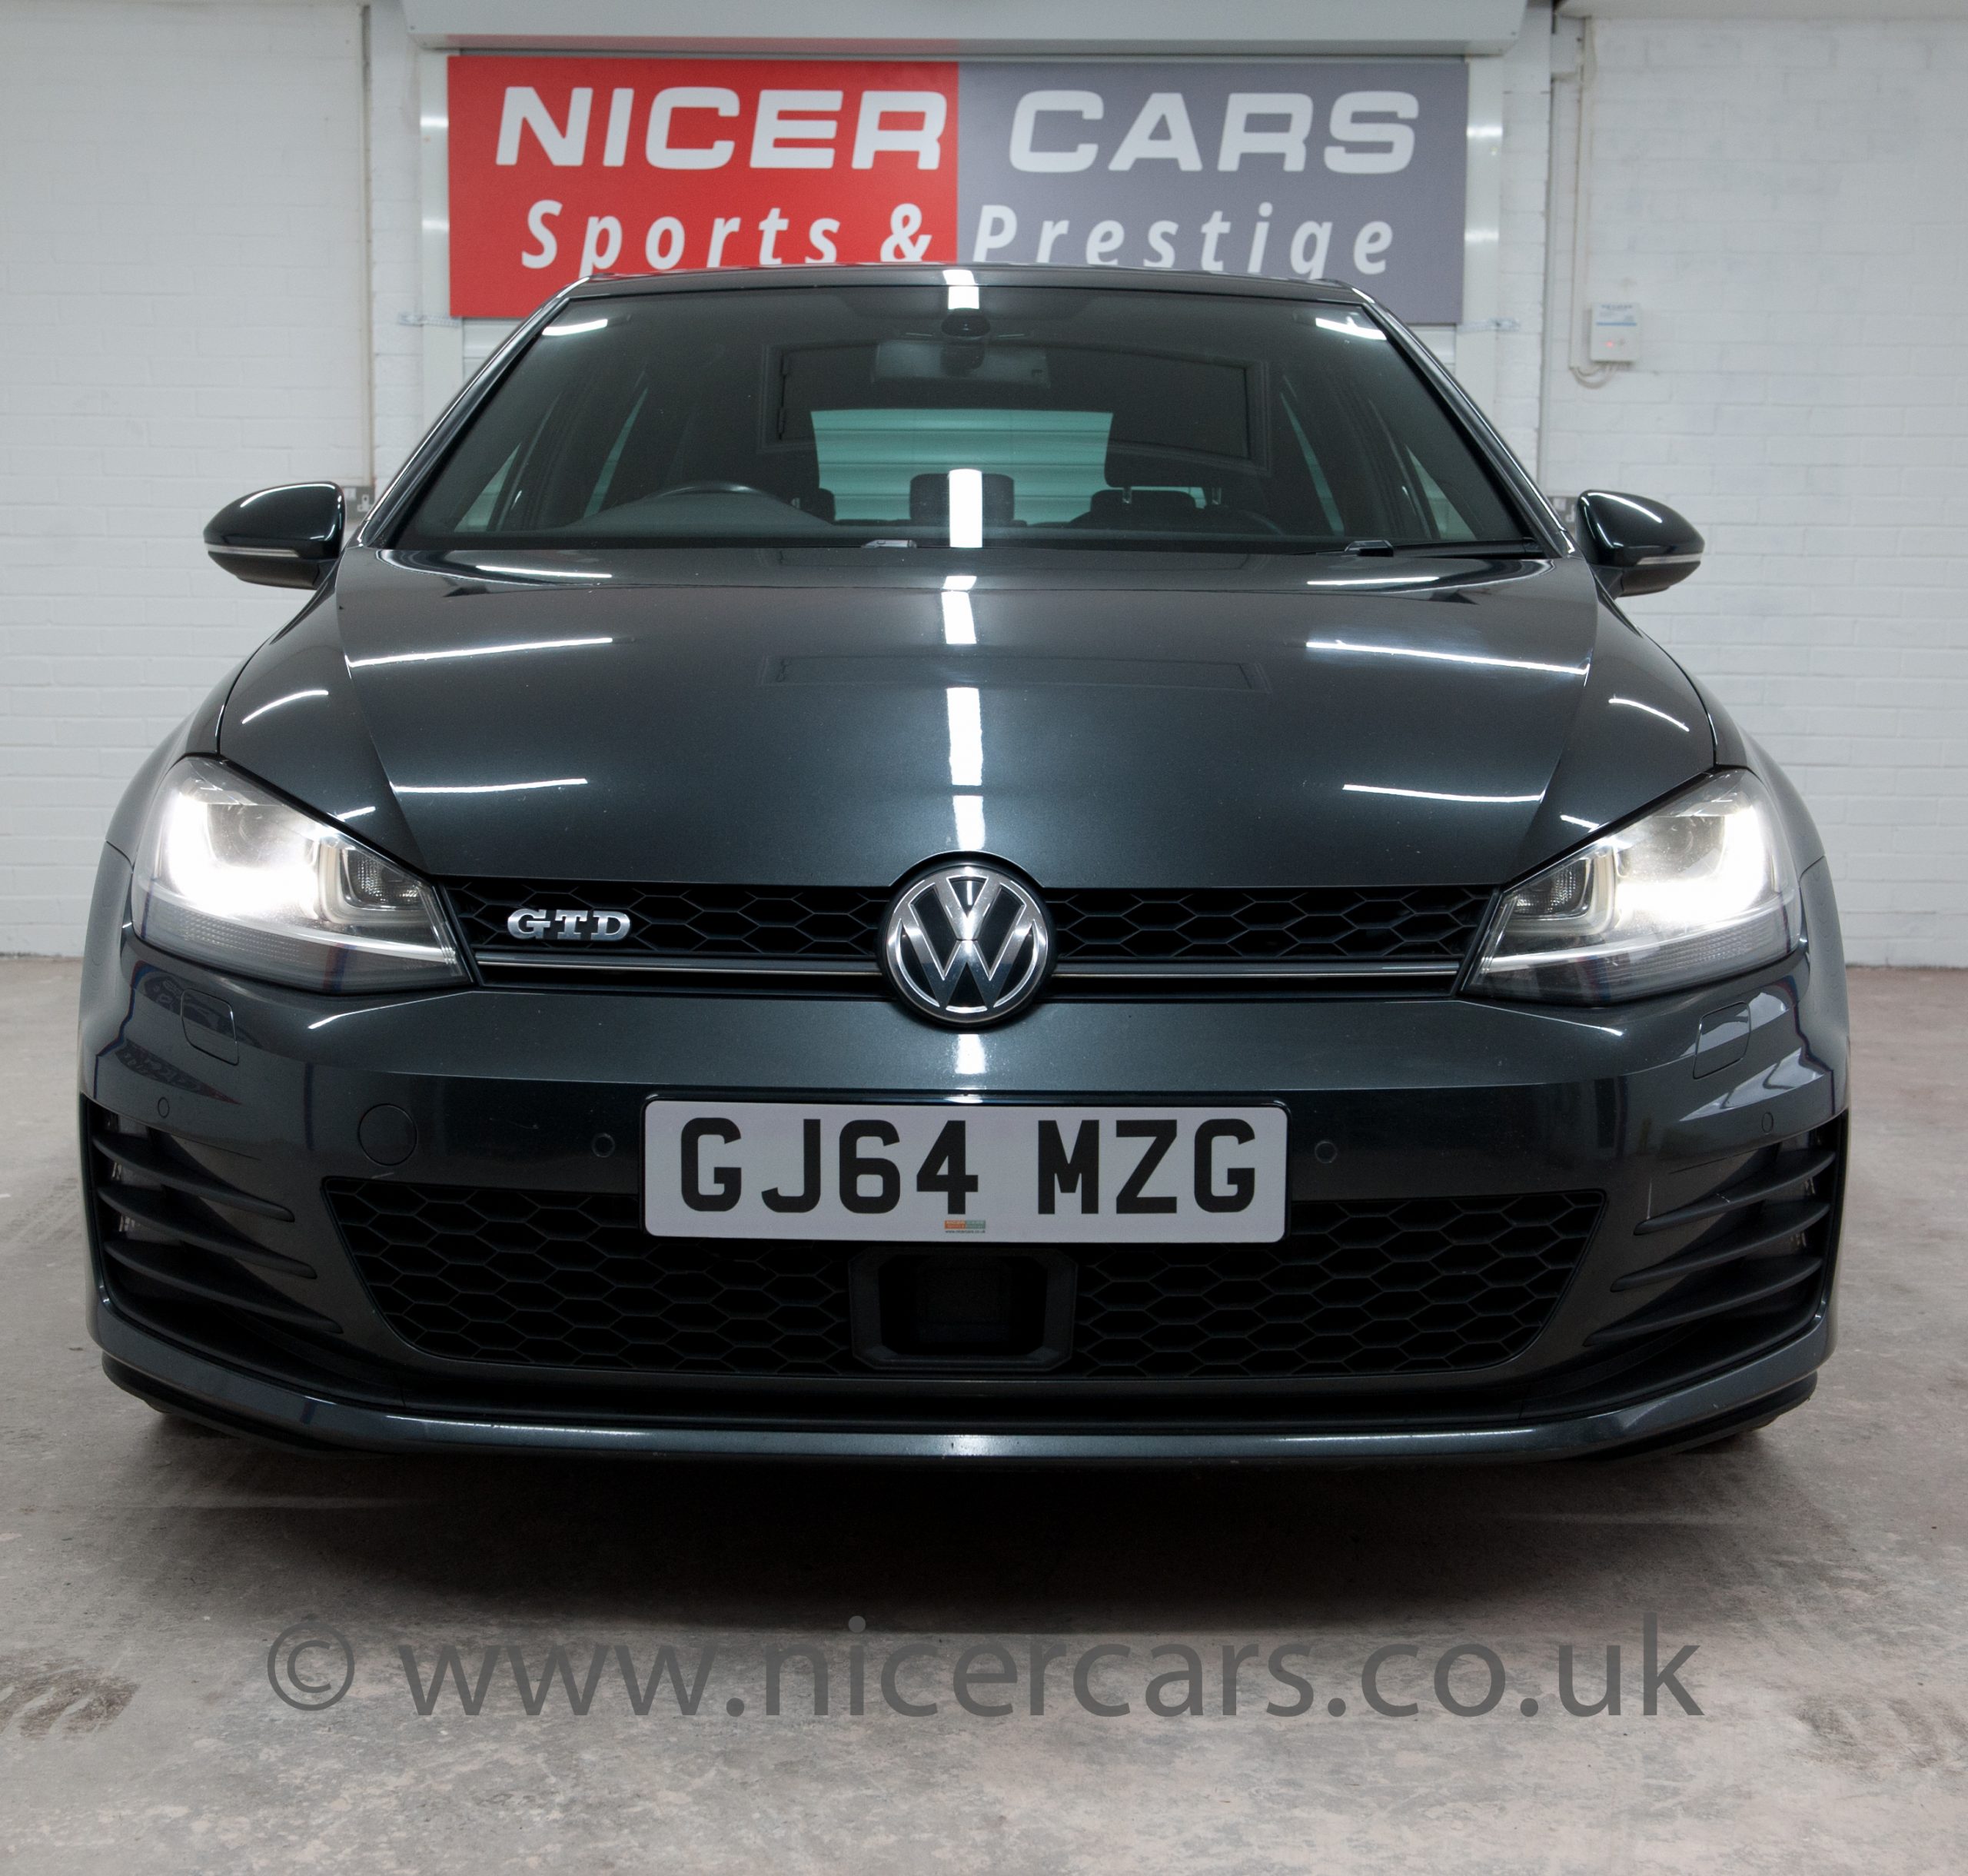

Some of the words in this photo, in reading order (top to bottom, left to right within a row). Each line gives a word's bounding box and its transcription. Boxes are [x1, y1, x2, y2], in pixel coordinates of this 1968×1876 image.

[496, 86, 948, 170] NICER
[1009, 89, 1419, 175] CARS
[521, 199, 841, 278] Sports
[879, 202, 932, 263] &
[972, 201, 1393, 280] Prestige
[507, 908, 631, 941] GTD
[680, 1117, 979, 1215] GJ64
[1038, 1118, 1255, 1215] MZG
